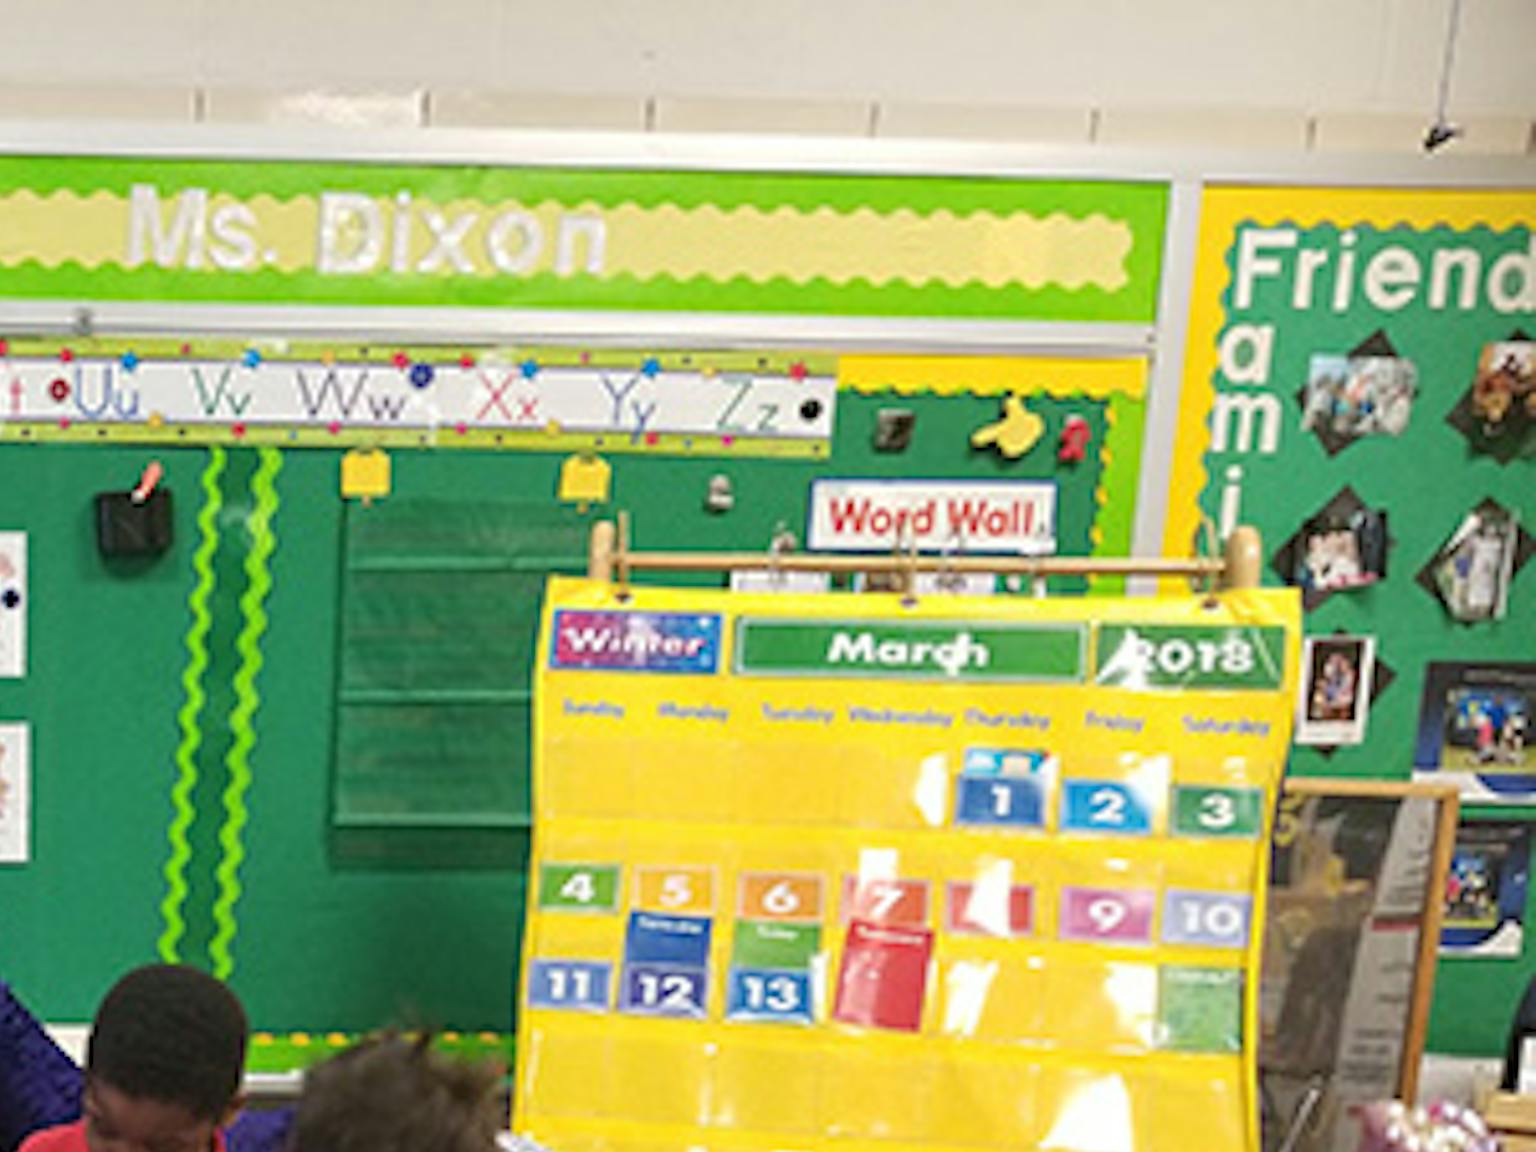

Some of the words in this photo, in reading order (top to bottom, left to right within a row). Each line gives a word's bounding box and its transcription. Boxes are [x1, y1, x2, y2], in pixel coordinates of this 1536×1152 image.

[126, 185, 278, 270] Ms.
[317, 190, 607, 276] Dixon
[74, 365, 141, 418] Uu
[192, 366, 252, 417] Vv
[297, 369, 407, 422] Ww
[476, 371, 540, 421] Xx
[601, 375, 657, 445] Yy
[718, 380, 779, 432] Zz
[830, 499, 937, 537] Word
[947, 499, 1035, 537] Wall
[566, 626, 706, 658] Winter
[827, 631, 990, 667] March
[991, 784, 1011, 816] 1
[1090, 788, 1125, 823] 2
[1197, 793, 1236, 828] 3
[560, 873, 595, 903] 4
[659, 874, 692, 906] 5
[762, 881, 798, 913] 6
[869, 886, 905, 918] 7
[1088, 898, 1126, 932] 9
[1182, 901, 1243, 935] 10
[548, 970, 590, 1000] 11
[638, 975, 695, 1008] 12
[741, 976, 799, 1011] 13
